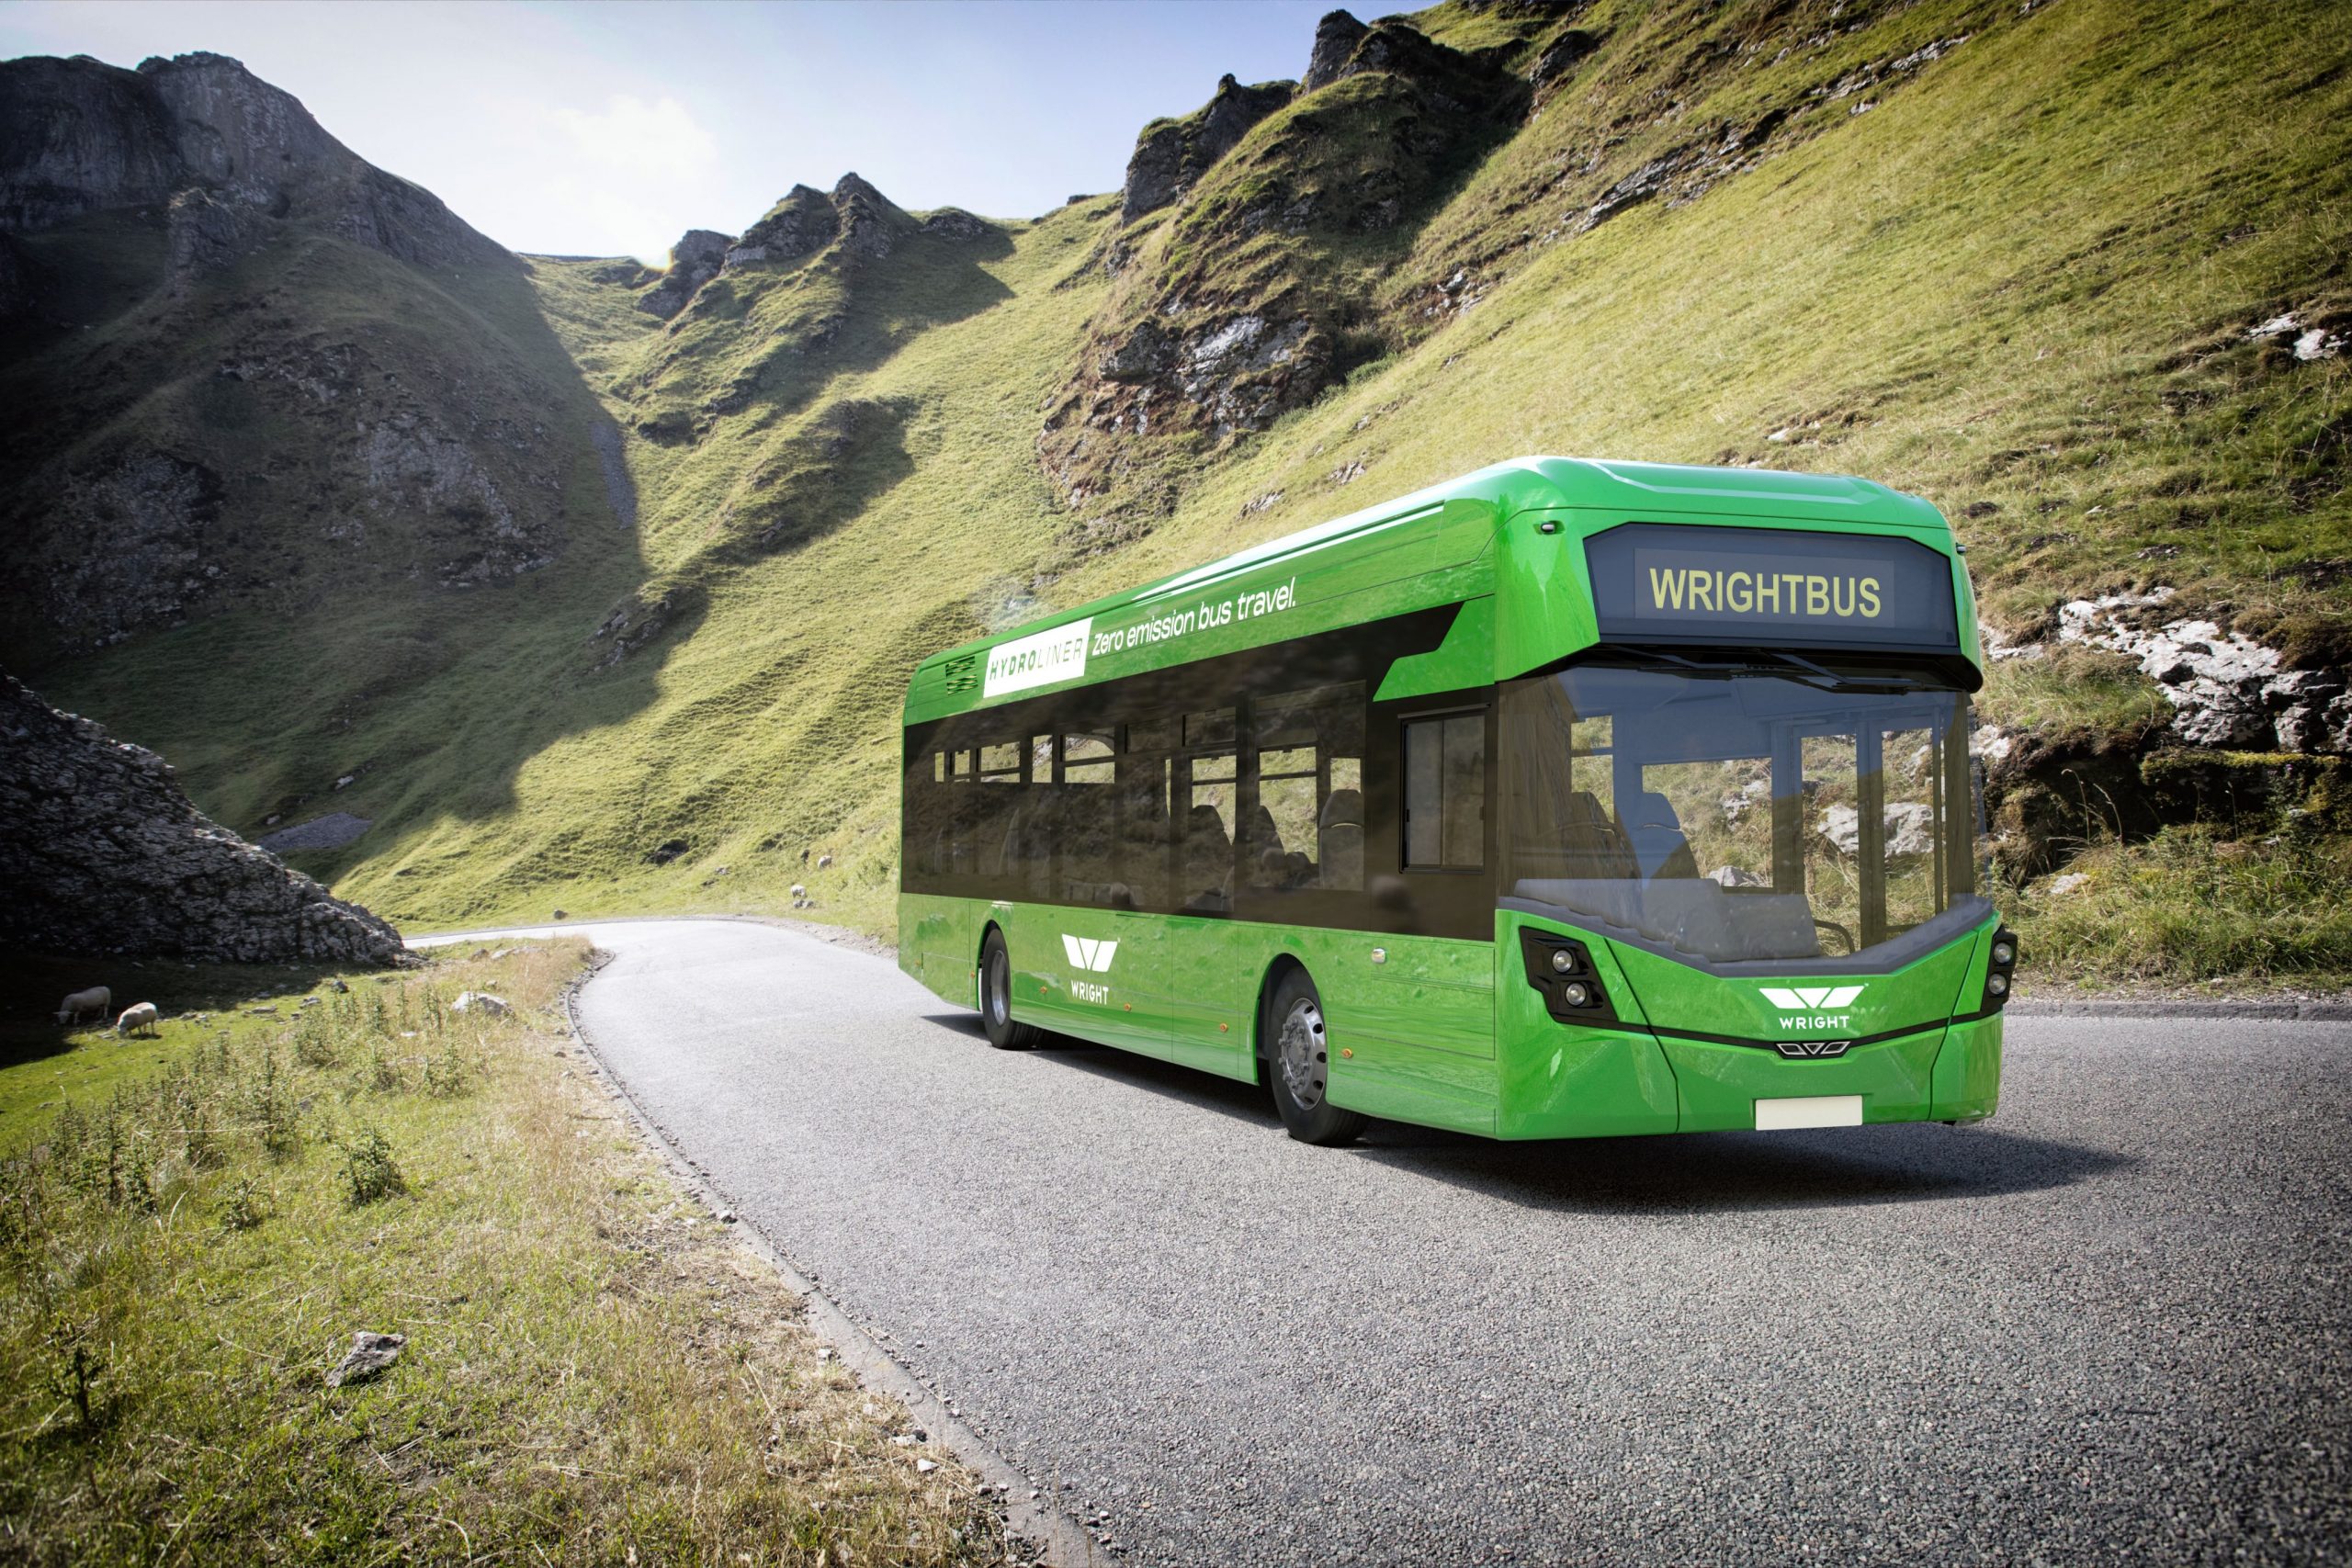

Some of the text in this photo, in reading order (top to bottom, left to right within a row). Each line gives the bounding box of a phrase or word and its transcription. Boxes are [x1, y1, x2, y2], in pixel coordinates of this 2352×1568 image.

[1649, 568, 1882, 618] WRIGHTBUS
[1091, 576, 1296, 657] zero emission bus travel.
[989, 637, 1084, 681] HYDROLINER
[1070, 979, 1109, 1006] WRIGHT
[1779, 1015, 1850, 1030] WRIGHT
